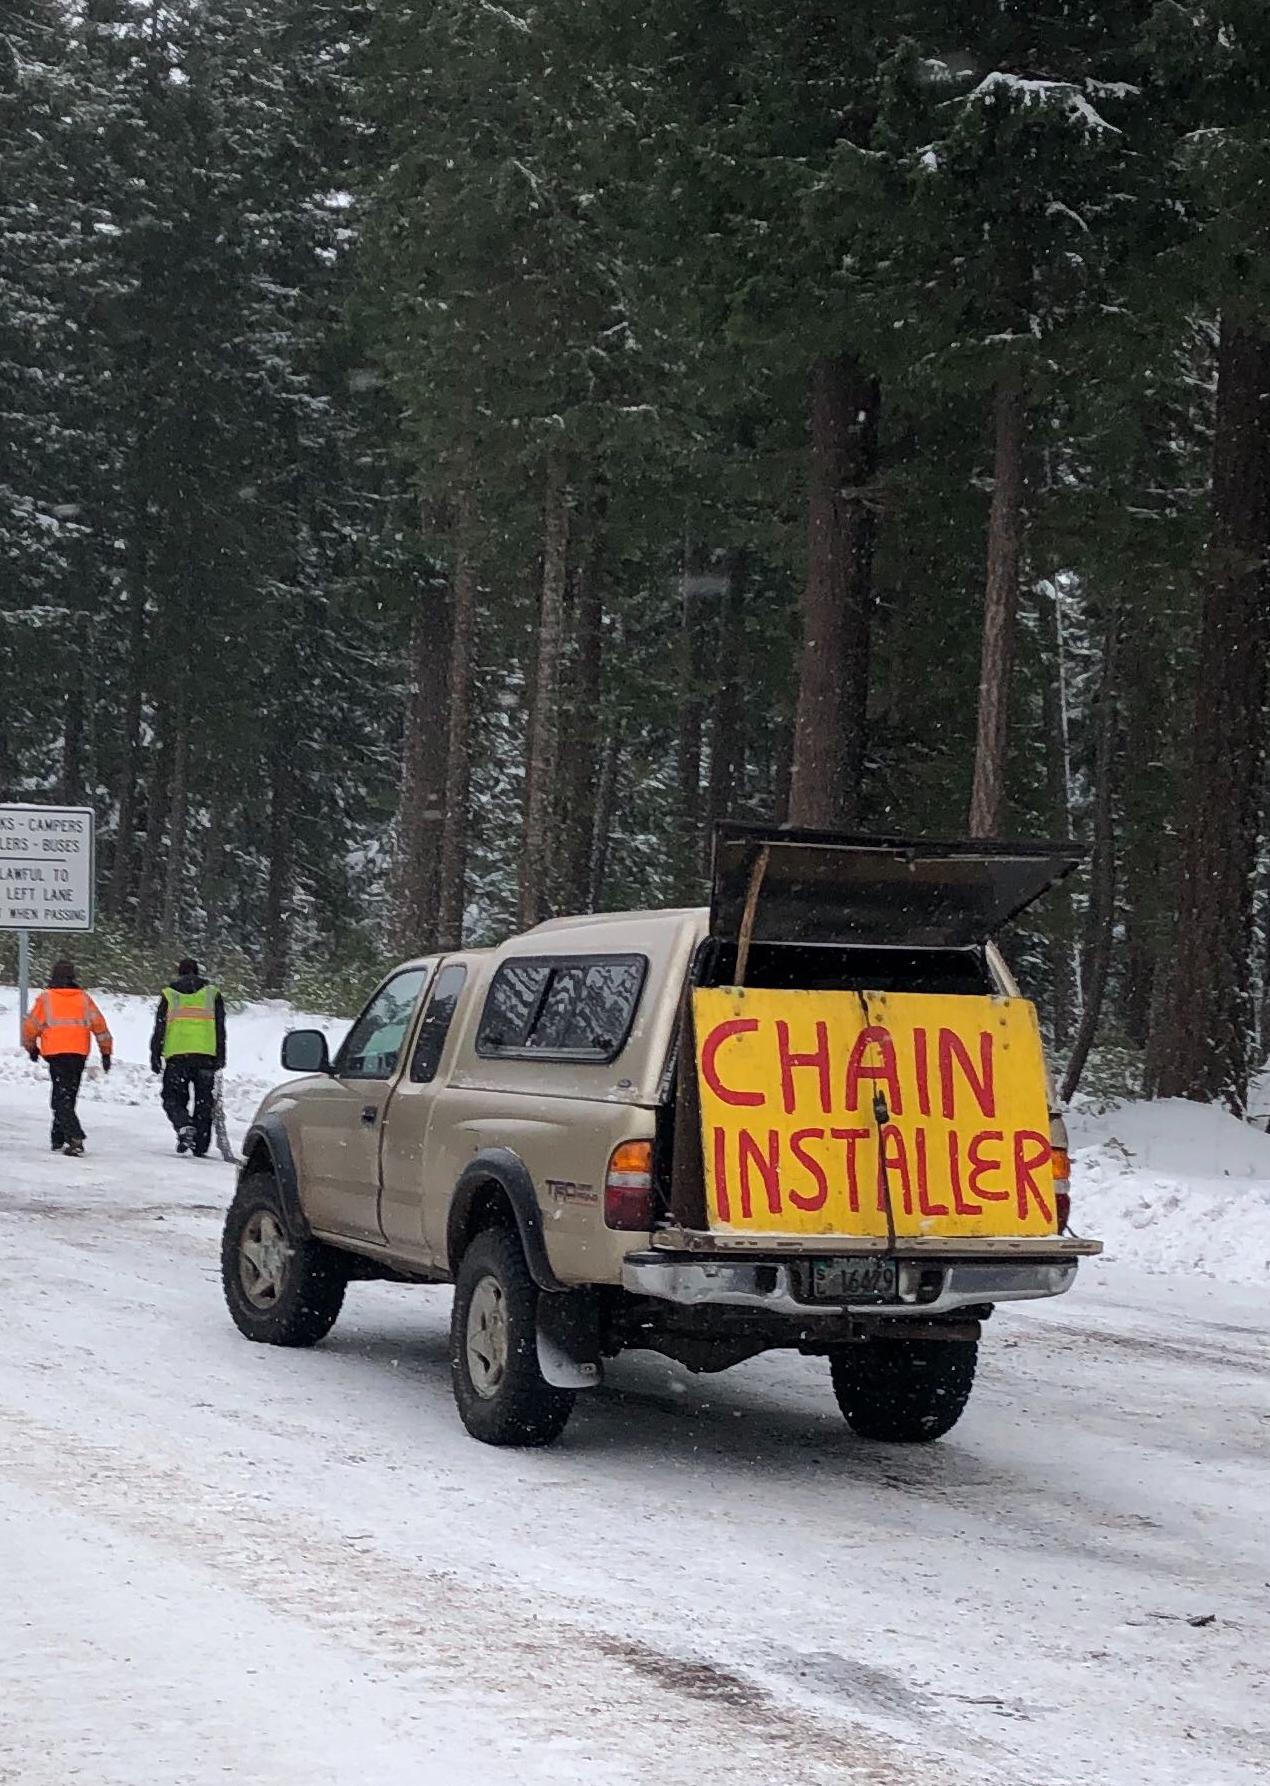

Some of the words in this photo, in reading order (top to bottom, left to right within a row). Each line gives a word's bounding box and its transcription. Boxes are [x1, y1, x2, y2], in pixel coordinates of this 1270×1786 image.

[29, 818, 84, 833] CAMPERS
[42, 838, 80, 853] BUSES
[53, 868, 69, 882] TO
[6, 887, 35, 901] LEFT
[43, 887, 74, 902] LANE
[10, 908, 38, 920] WHEN
[44, 908, 86, 922] PASSING
[701, 1018, 996, 1120] CHAIN
[714, 1126, 1053, 1224] INSTALLER
